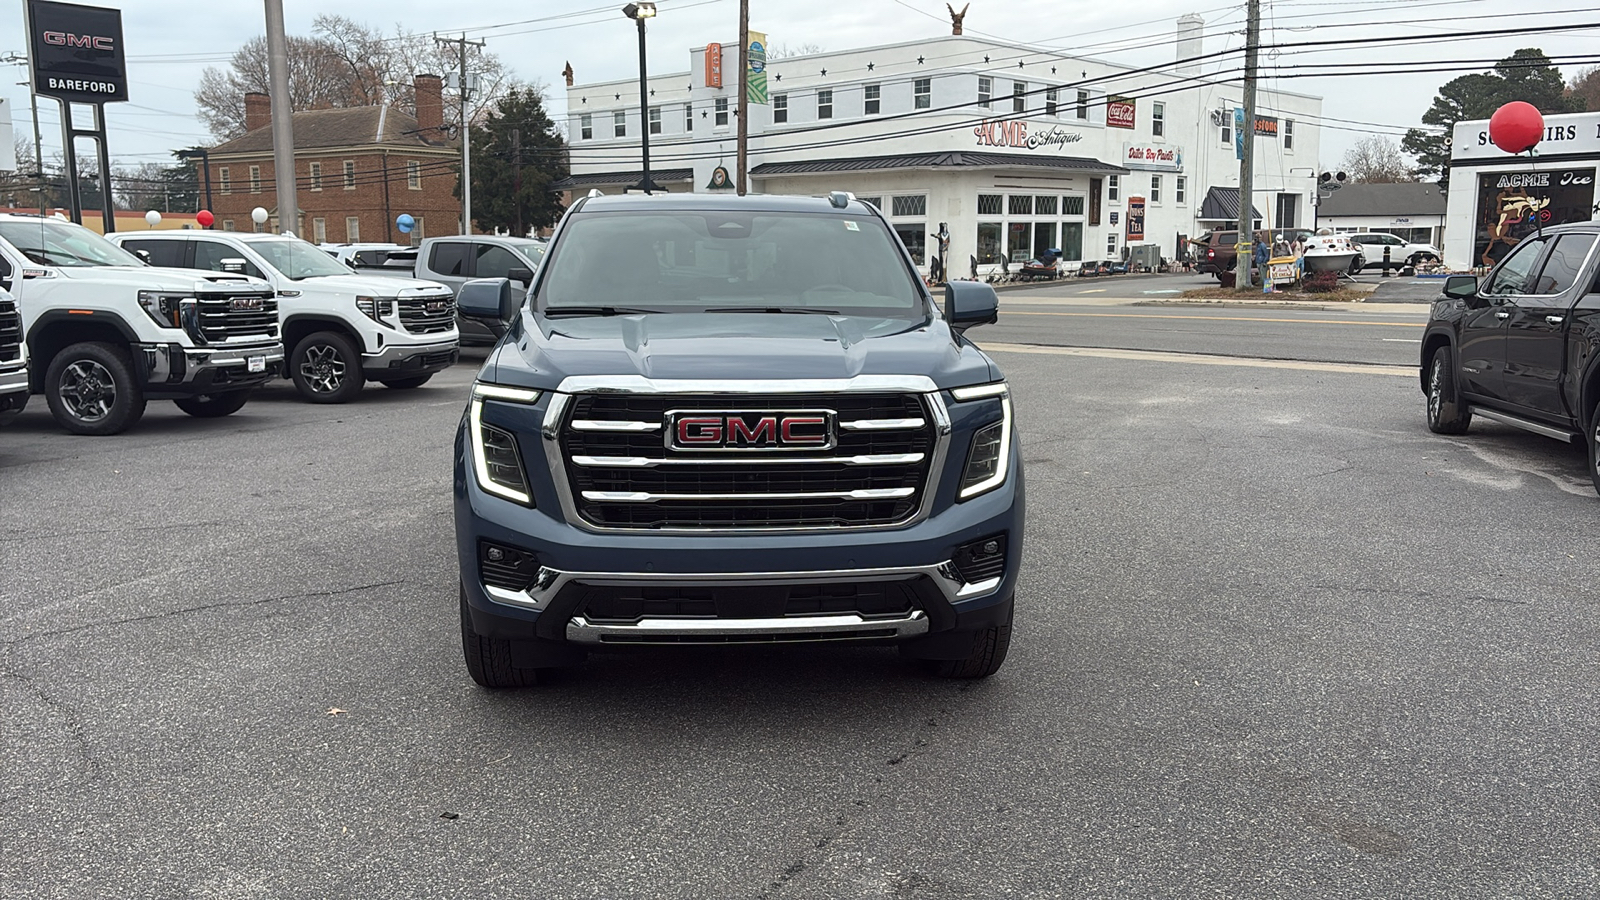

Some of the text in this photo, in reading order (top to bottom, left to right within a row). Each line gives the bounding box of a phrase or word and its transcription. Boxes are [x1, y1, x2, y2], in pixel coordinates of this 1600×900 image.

[43, 30, 114, 51] GMC
[712, 46, 720, 84] ACME
[48, 77, 116, 94] BAREFORD
[1254, 119, 1277, 133] estone
[974, 119, 1027, 148] ACME
[1038, 124, 1082, 151] Antiques
[1128, 147, 1174, 163] Dutch Boy Paints
[1496, 171, 1593, 188] ACME Ice
[1131, 221, 1142, 232] TEA
[678, 417, 825, 444] GMC
